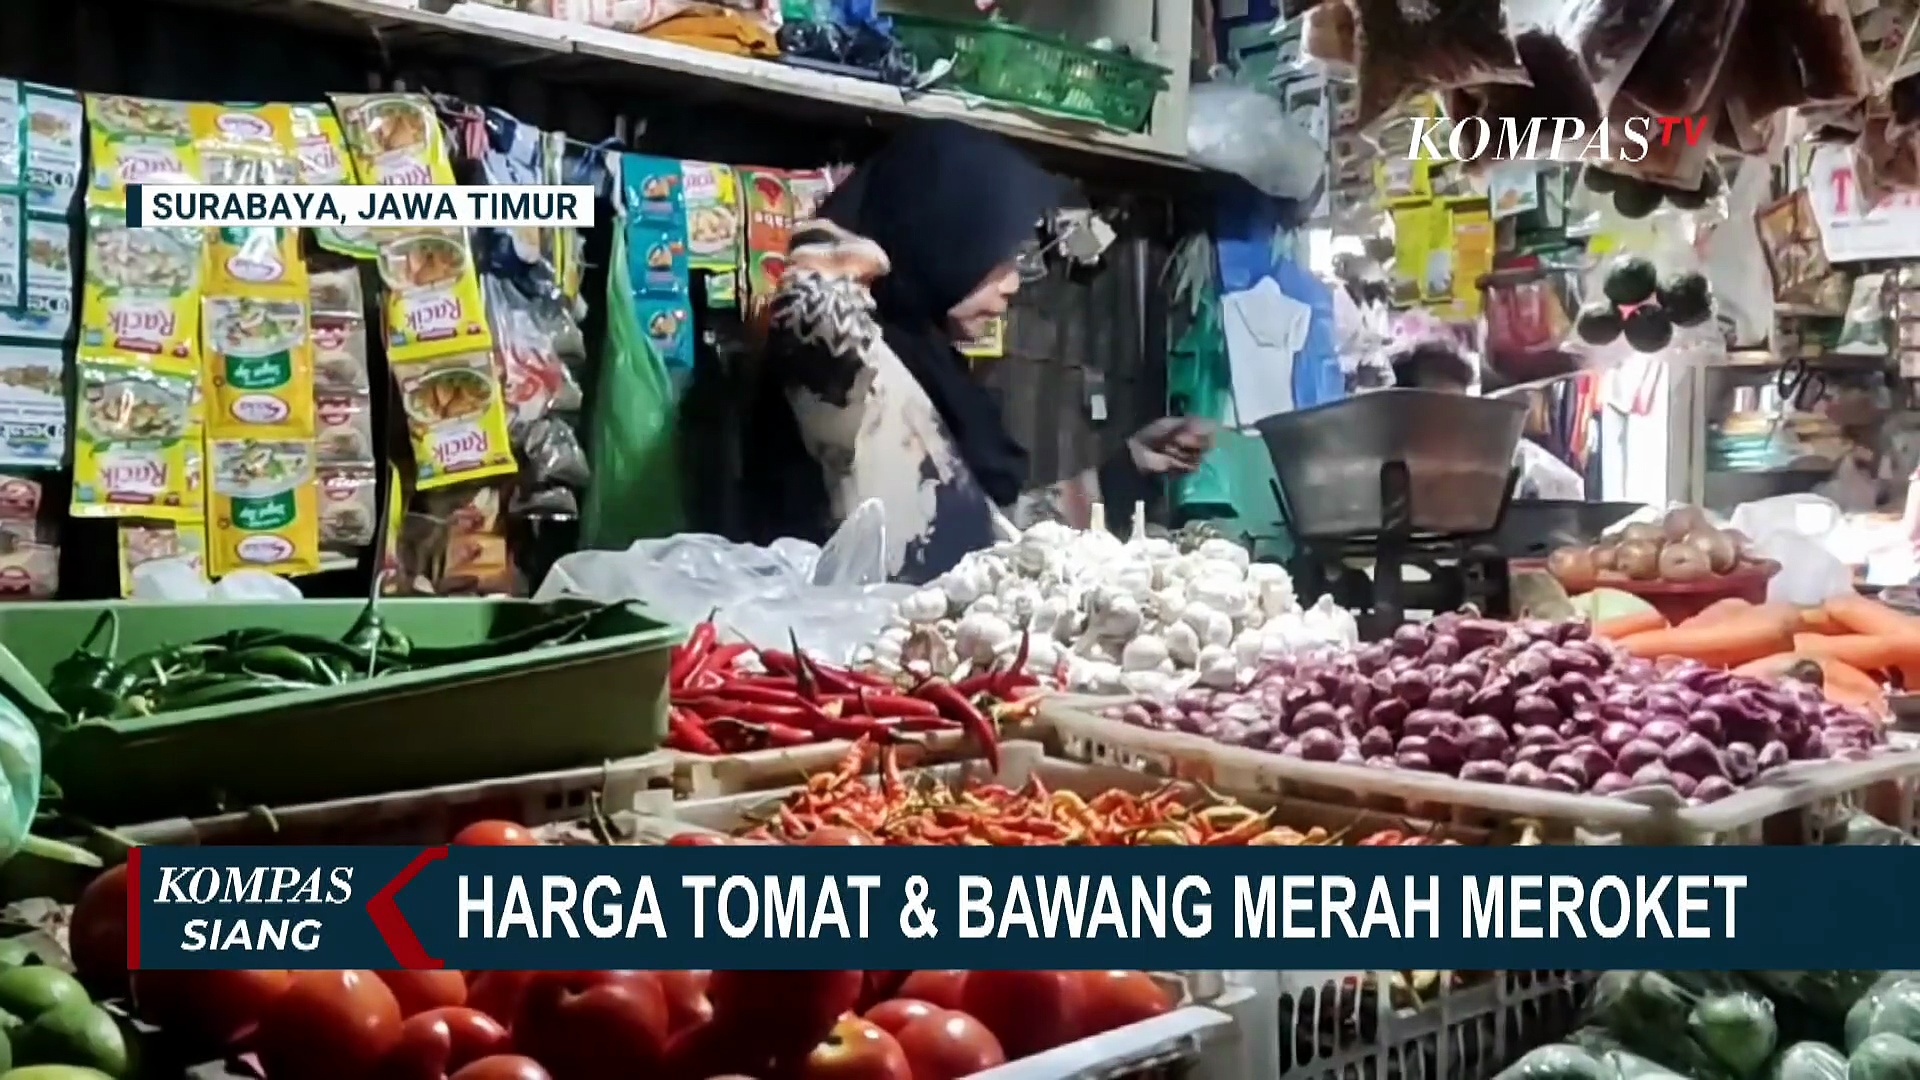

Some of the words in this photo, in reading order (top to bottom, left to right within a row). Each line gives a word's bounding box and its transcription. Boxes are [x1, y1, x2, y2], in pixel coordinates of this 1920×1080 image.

[107, 309, 177, 337] Racik
[406, 297, 463, 330] Racik
[432, 430, 489, 464] Racik
[101, 462, 168, 488] Racik
